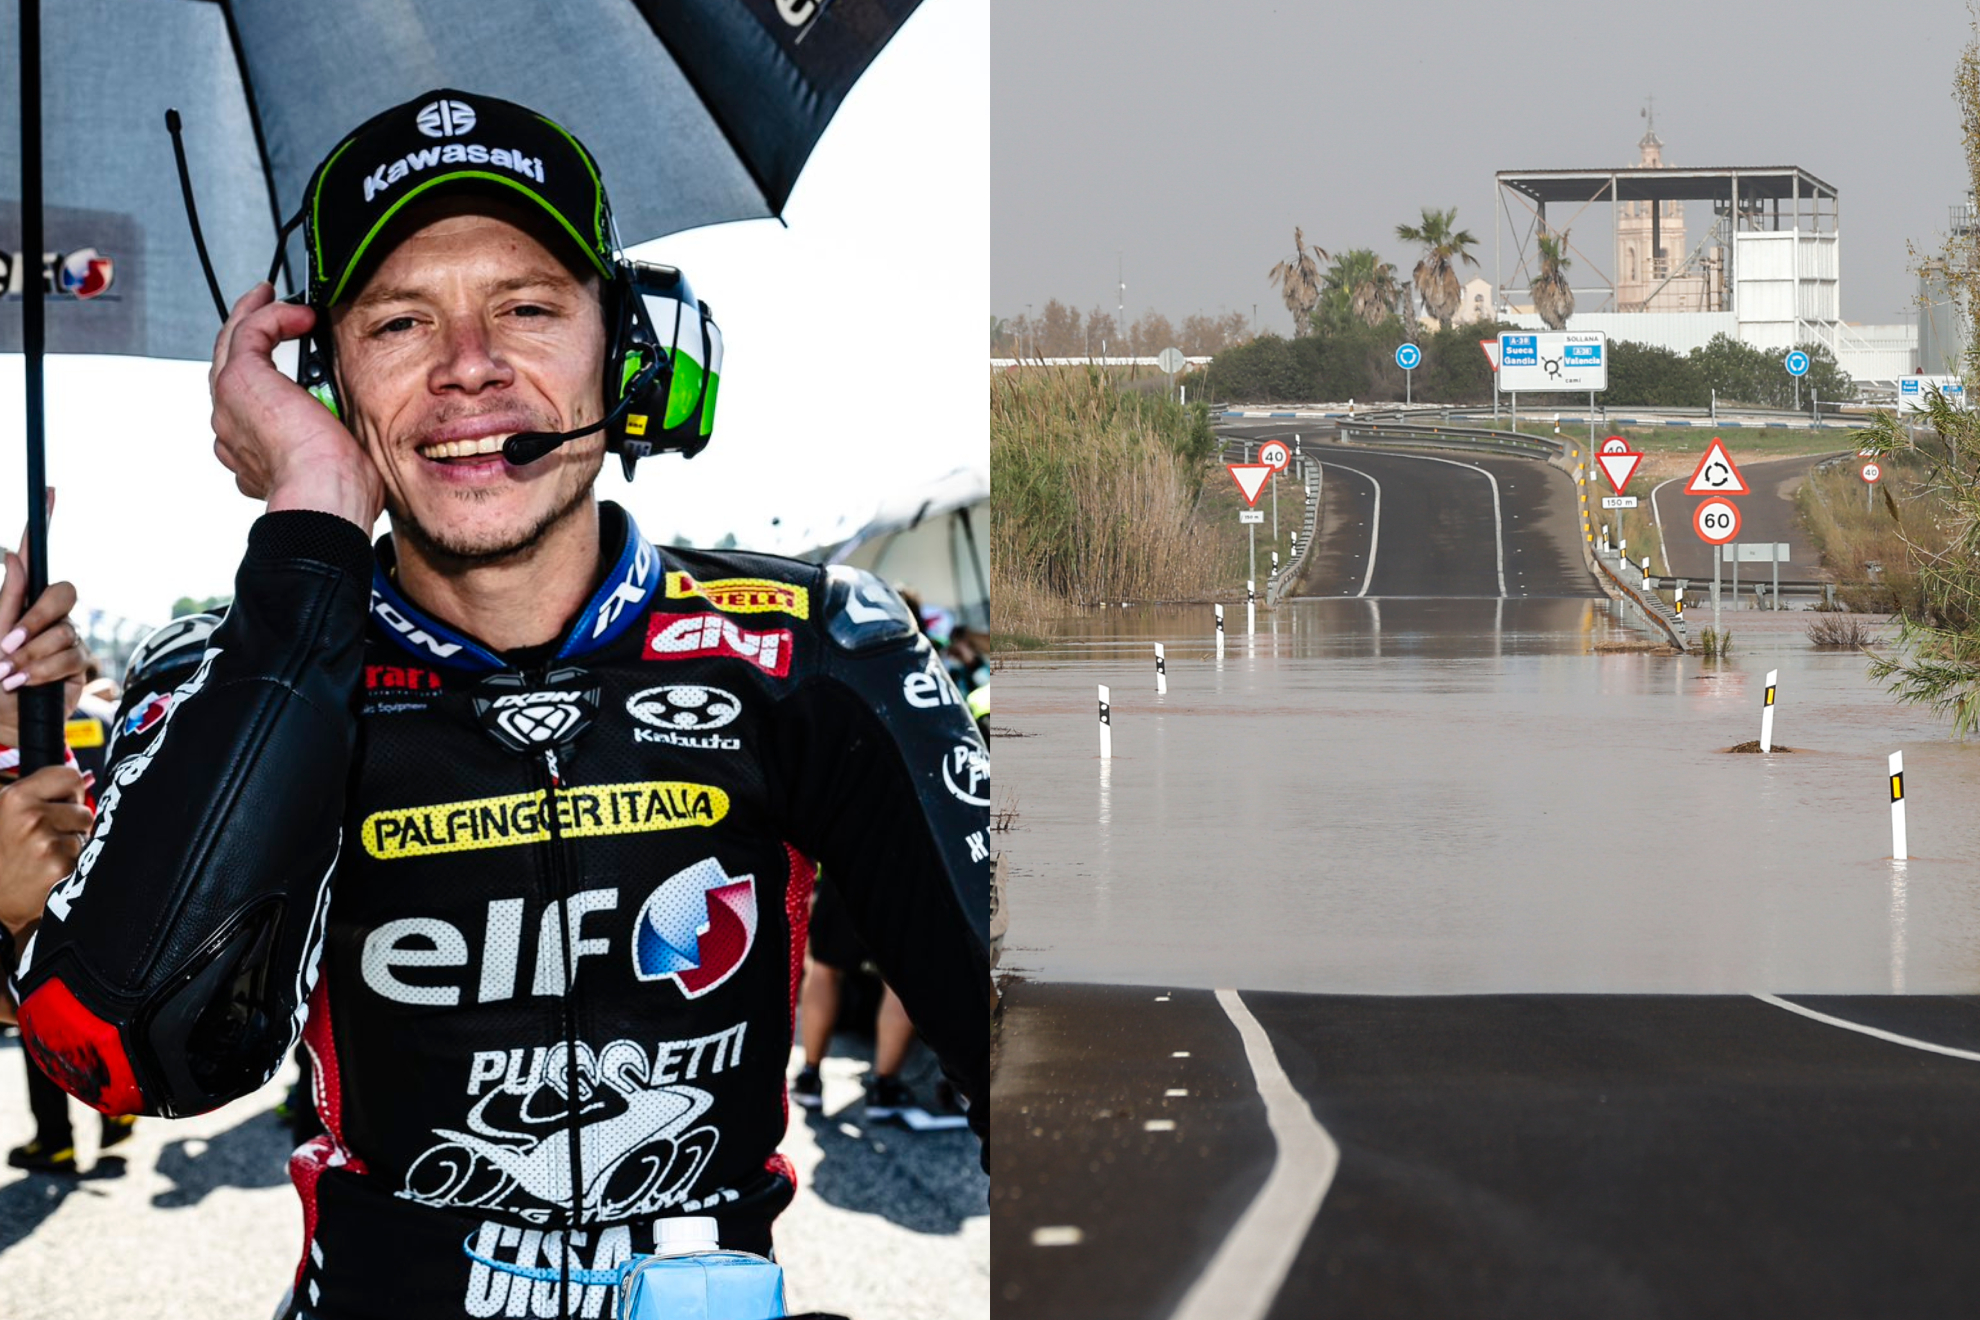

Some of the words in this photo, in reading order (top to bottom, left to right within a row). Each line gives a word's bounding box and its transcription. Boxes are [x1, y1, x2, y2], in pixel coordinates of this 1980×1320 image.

[363, 143, 545, 202] Kawasaki
[1506, 346, 1534, 354] Sueca
[1504, 356, 1535, 365] Gandia
[1565, 357, 1600, 365] Valencia
[1265, 451, 1283, 462] 40
[1704, 513, 1729, 529] 60
[651, 615, 780, 669] GIVI
[493, 691, 582, 708] IXON
[633, 727, 741, 750] Kabuto
[374, 794, 599, 852] PALFINGER
[609, 788, 714, 825] ITALIA
[361, 888, 619, 1006] elf
[464, 1220, 632, 1318] CISA
